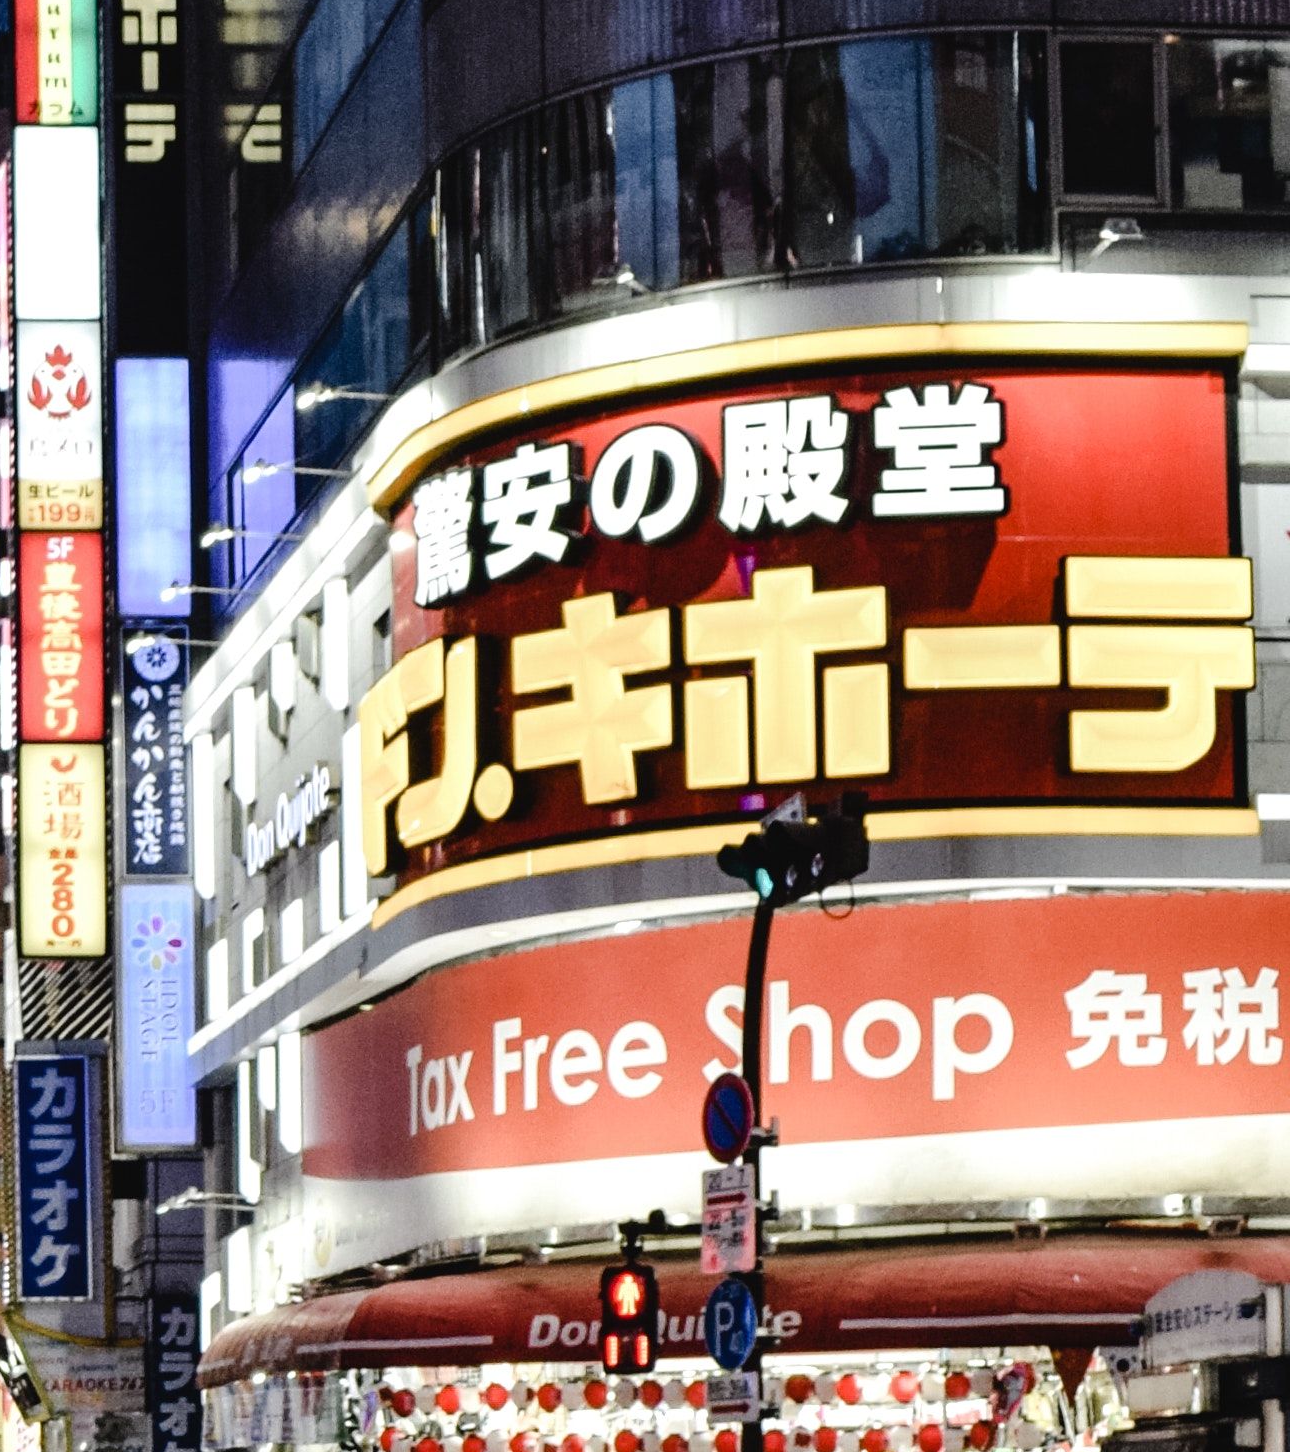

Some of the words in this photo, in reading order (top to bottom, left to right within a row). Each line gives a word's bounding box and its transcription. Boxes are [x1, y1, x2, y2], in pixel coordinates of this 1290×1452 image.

[411, 382, 1007, 609] 驚安の殿堂
[47, 536, 74, 560] 5F
[130, 683, 165, 865] かんかん商店
[248, 819, 275, 878] Don
[276, 763, 331, 849] Quijote
[51, 863, 76, 938] 280
[141, 978, 159, 1060] STAGE
[161, 980, 178, 1041] IDOL
[406, 1044, 475, 1136] Tax
[491, 1016, 669, 1116] Free
[703, 978, 1015, 1101] Shop
[1064, 967, 1284, 1068] 免税
[140, 1089, 178, 1115] 5F
[27, 1066, 81, 1290] カラオケ
